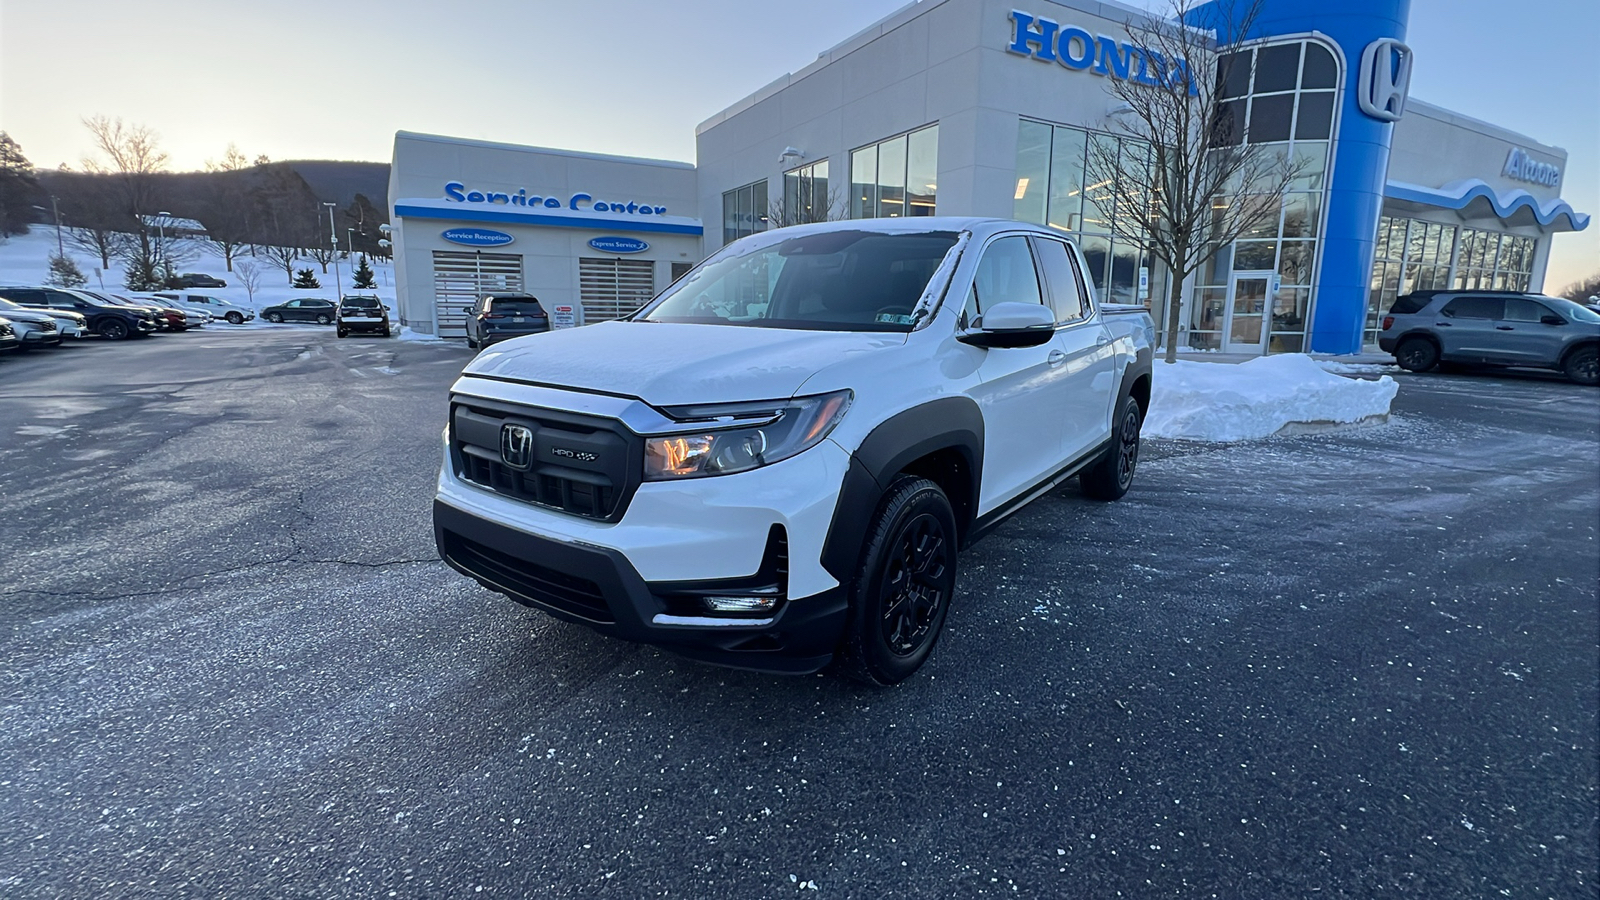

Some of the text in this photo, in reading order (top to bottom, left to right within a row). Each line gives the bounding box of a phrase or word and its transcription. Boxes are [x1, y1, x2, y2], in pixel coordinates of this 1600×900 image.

[1007, 9, 1199, 98] HONDA
[1502, 147, 1559, 188] Altoona
[444, 181, 667, 215] Service Center
[446, 231, 510, 242] Service Reception
[591, 240, 637, 249] Express Service
[552, 448, 574, 458] HPD
